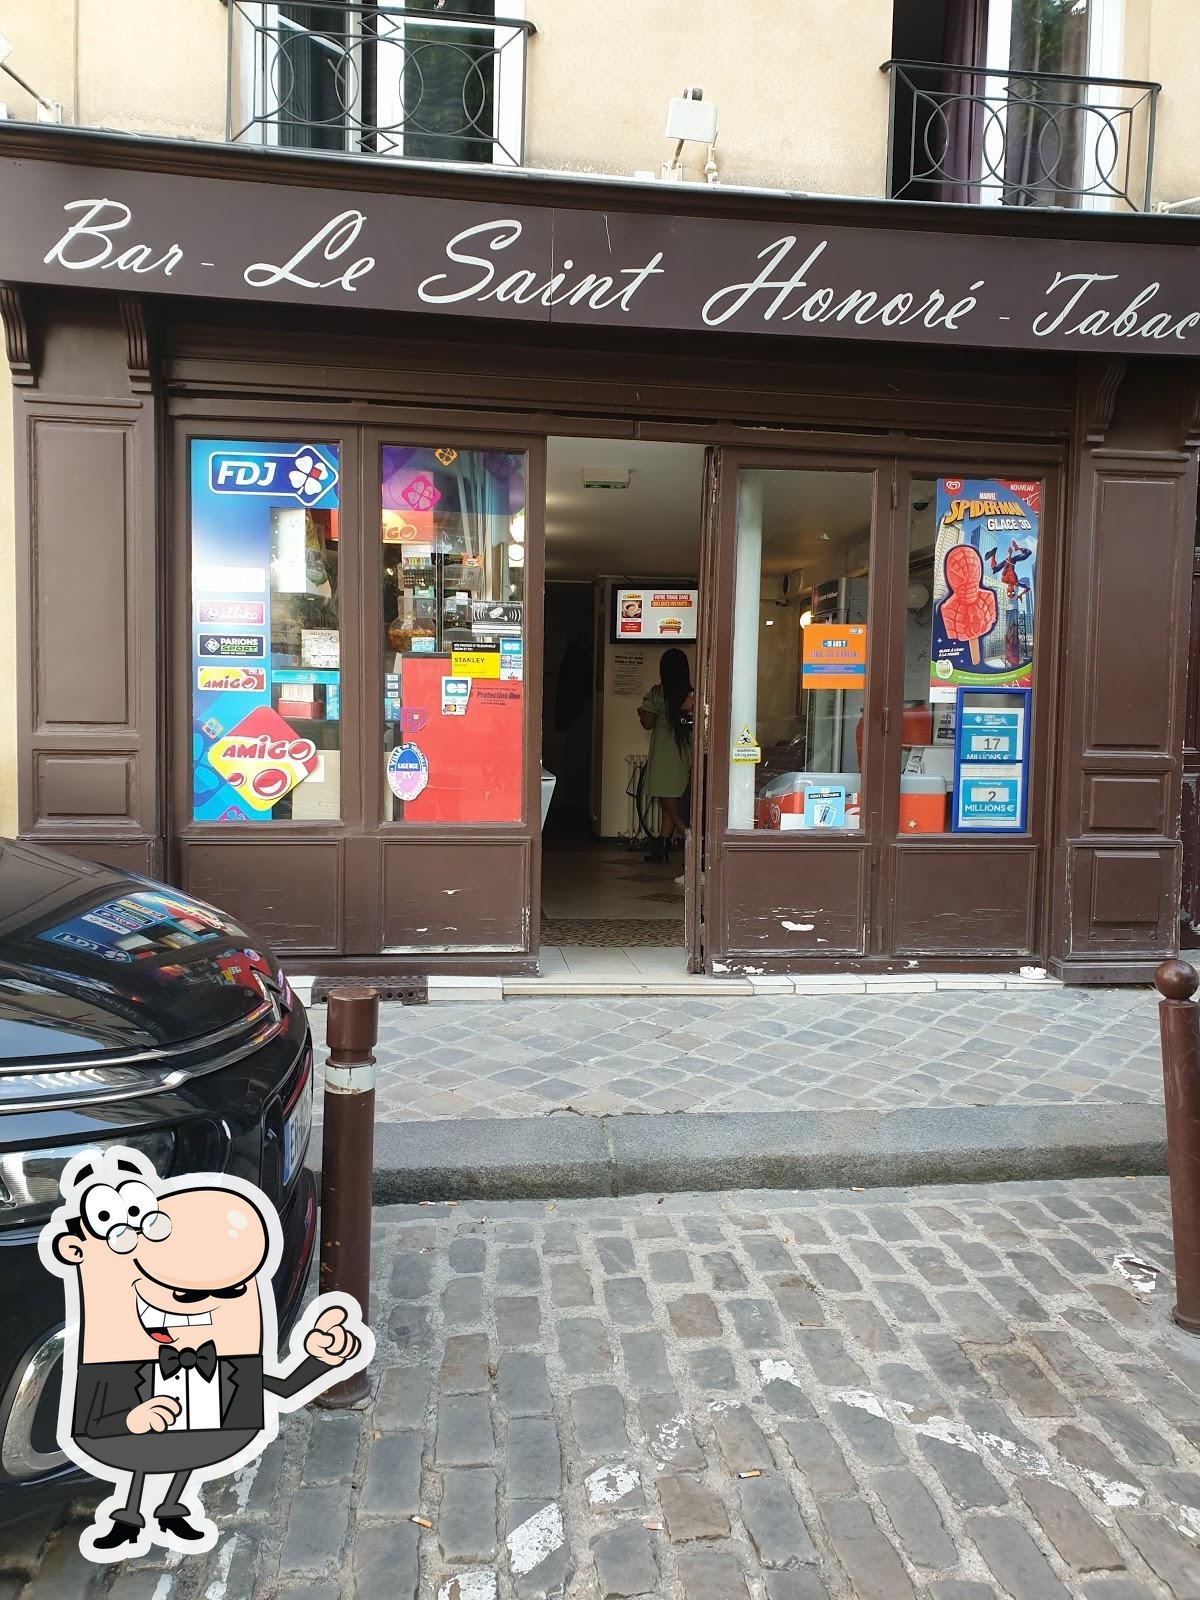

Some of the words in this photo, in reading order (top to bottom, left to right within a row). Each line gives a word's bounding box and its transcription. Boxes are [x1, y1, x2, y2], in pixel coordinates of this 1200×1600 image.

[44, 197, 185, 277] Bar
[243, 209, 377, 291] Le
[417, 219, 664, 312] Saint
[701, 235, 985, 330] Honoré
[1032, 271, 1200, 340] Tabac
[217, 460, 277, 487] FDJ
[1010, 484, 1034, 492] NOUVEAU
[979, 492, 997, 500] MARVEL
[987, 519, 1019, 531] GLACE
[1019, 519, 1032, 531] 3D
[220, 638, 259, 646] PARIONS
[446, 682, 468, 694] CB
[476, 691, 508, 700] Protection
[984, 738, 1001, 750] 17
[988, 790, 997, 802] 2
[964, 804, 1006, 812] MILLIONS
